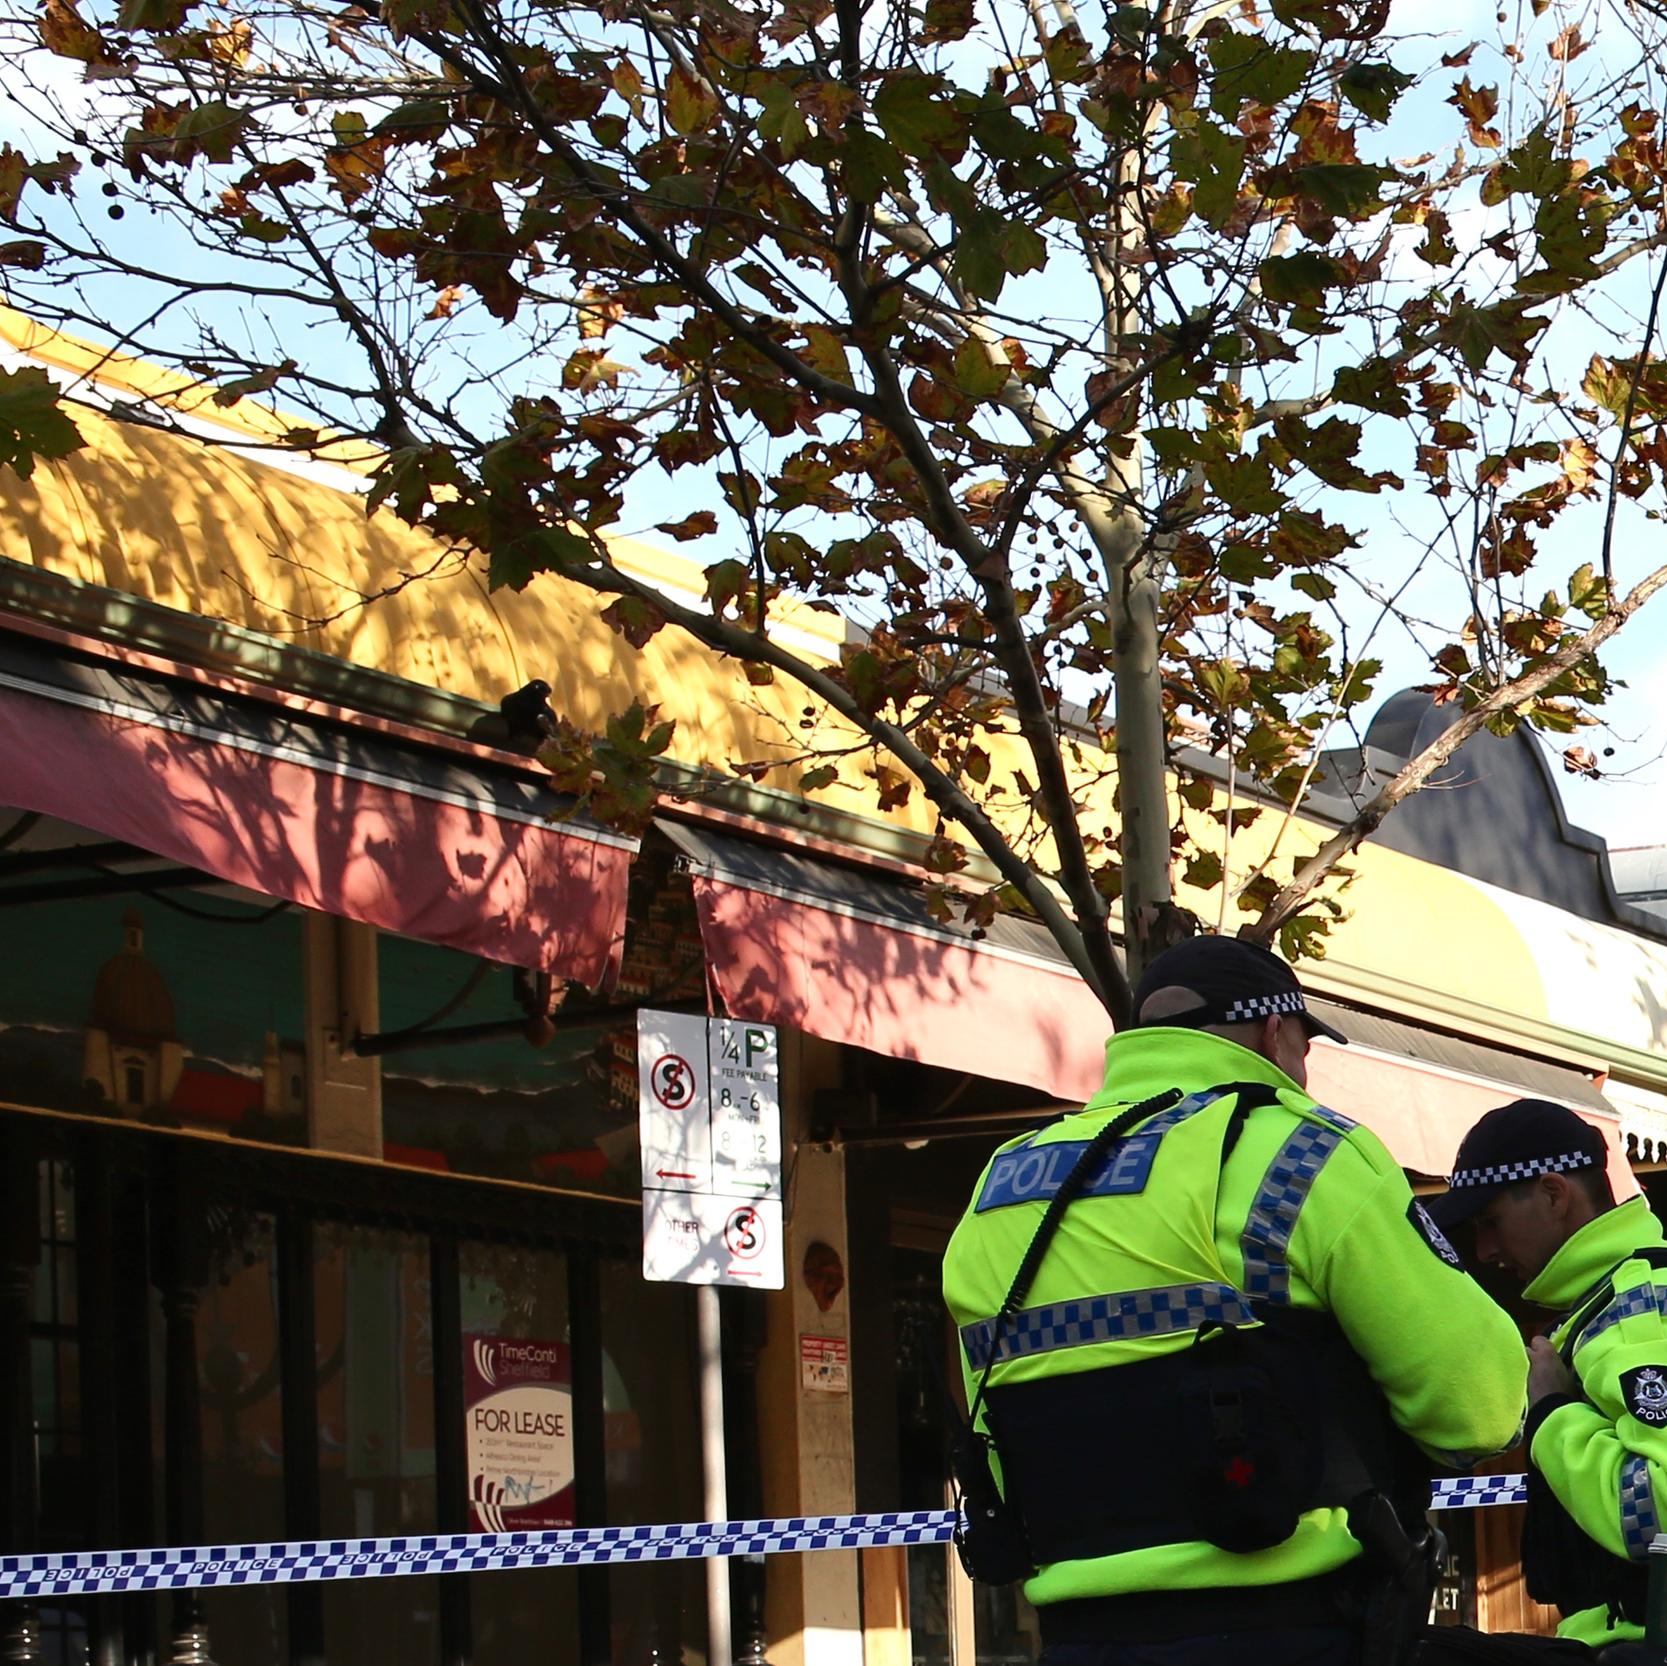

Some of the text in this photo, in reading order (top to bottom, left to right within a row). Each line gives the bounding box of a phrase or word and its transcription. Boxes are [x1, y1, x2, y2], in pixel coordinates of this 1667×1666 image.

[745, 1029, 769, 1068] P
[722, 1068, 768, 1083] FEE PAYABLE
[984, 1143, 1147, 1201] POLE
[475, 1408, 565, 1437] FOR LEASE
[193, 1558, 281, 1573] POLICE
[342, 1550, 433, 1565] POLICE
[45, 1566, 134, 1582] POLICE
